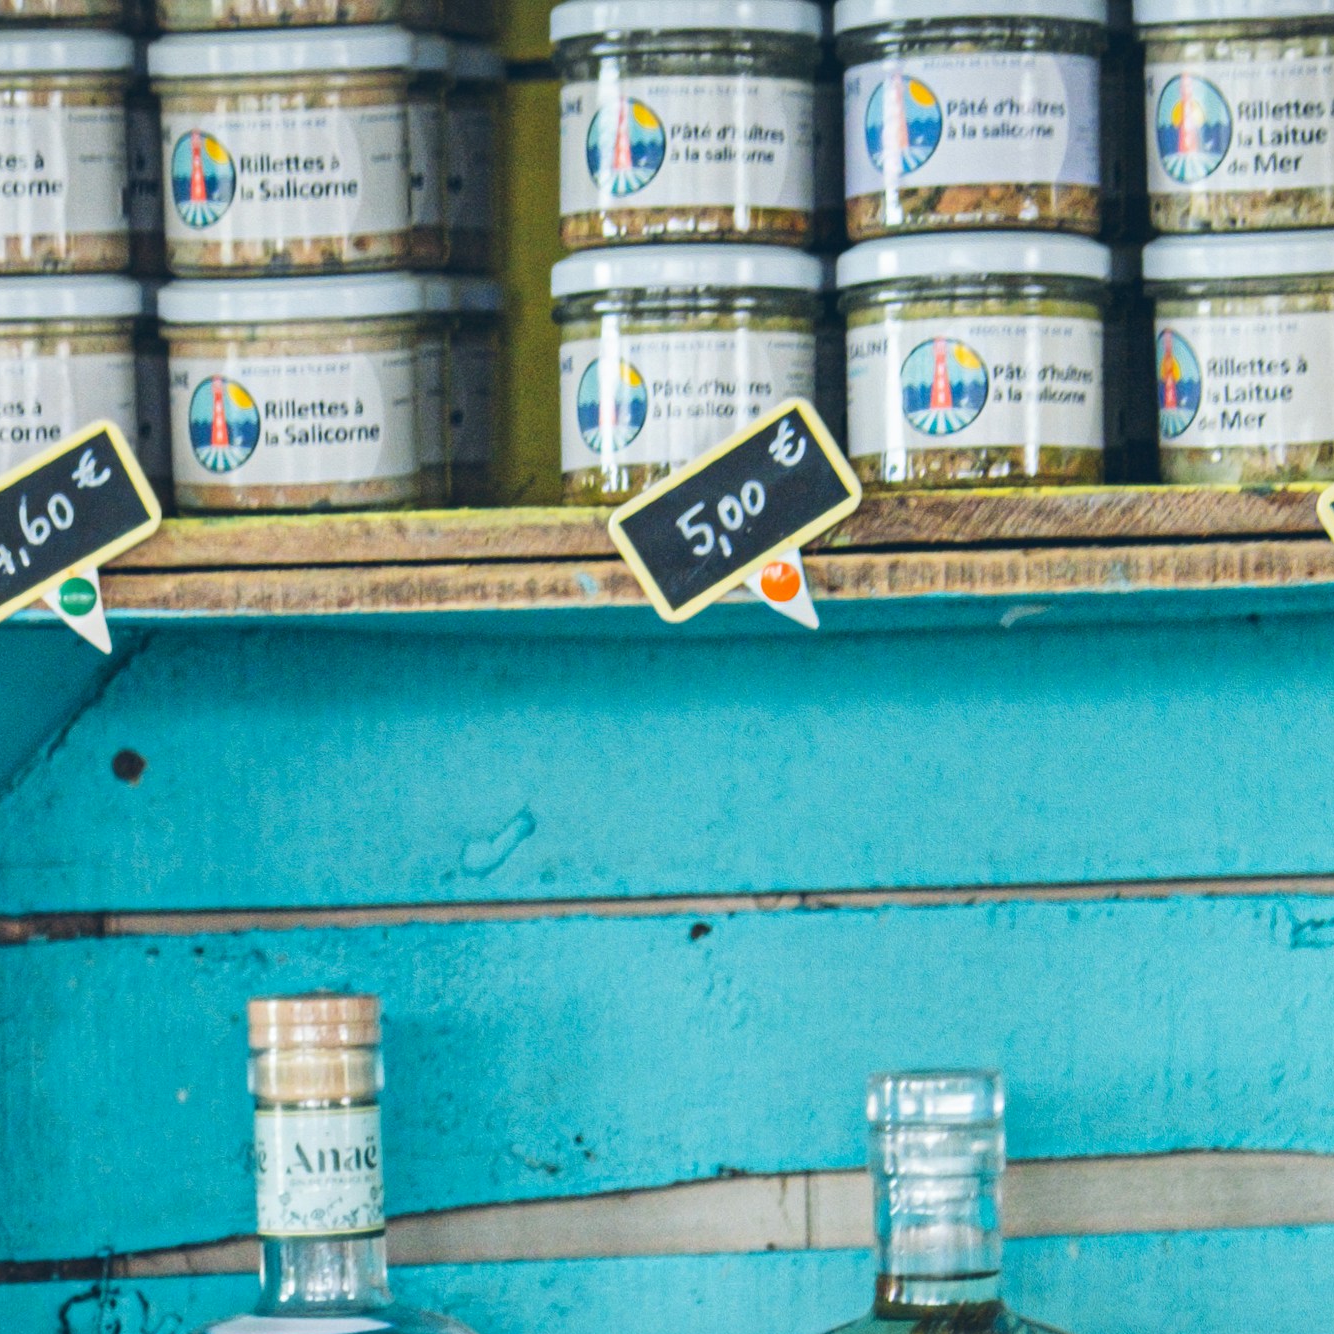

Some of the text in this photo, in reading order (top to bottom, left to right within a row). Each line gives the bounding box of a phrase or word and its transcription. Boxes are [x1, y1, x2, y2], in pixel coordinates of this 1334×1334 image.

[1258, 124, 1328, 147] Laitue
[239, 153, 325, 176] Rillettes
[1254, 151, 1304, 175] Mer
[259, 178, 358, 201] Salicorne
[1224, 383, 1294, 404] Laitue
[264, 400, 349, 421] Rillettes
[1220, 410, 1267, 430] Mer
[284, 423, 381, 446] Salicorne
[674, 479, 767, 558] 5,00
[285, 1135, 378, 1176] Anaë
